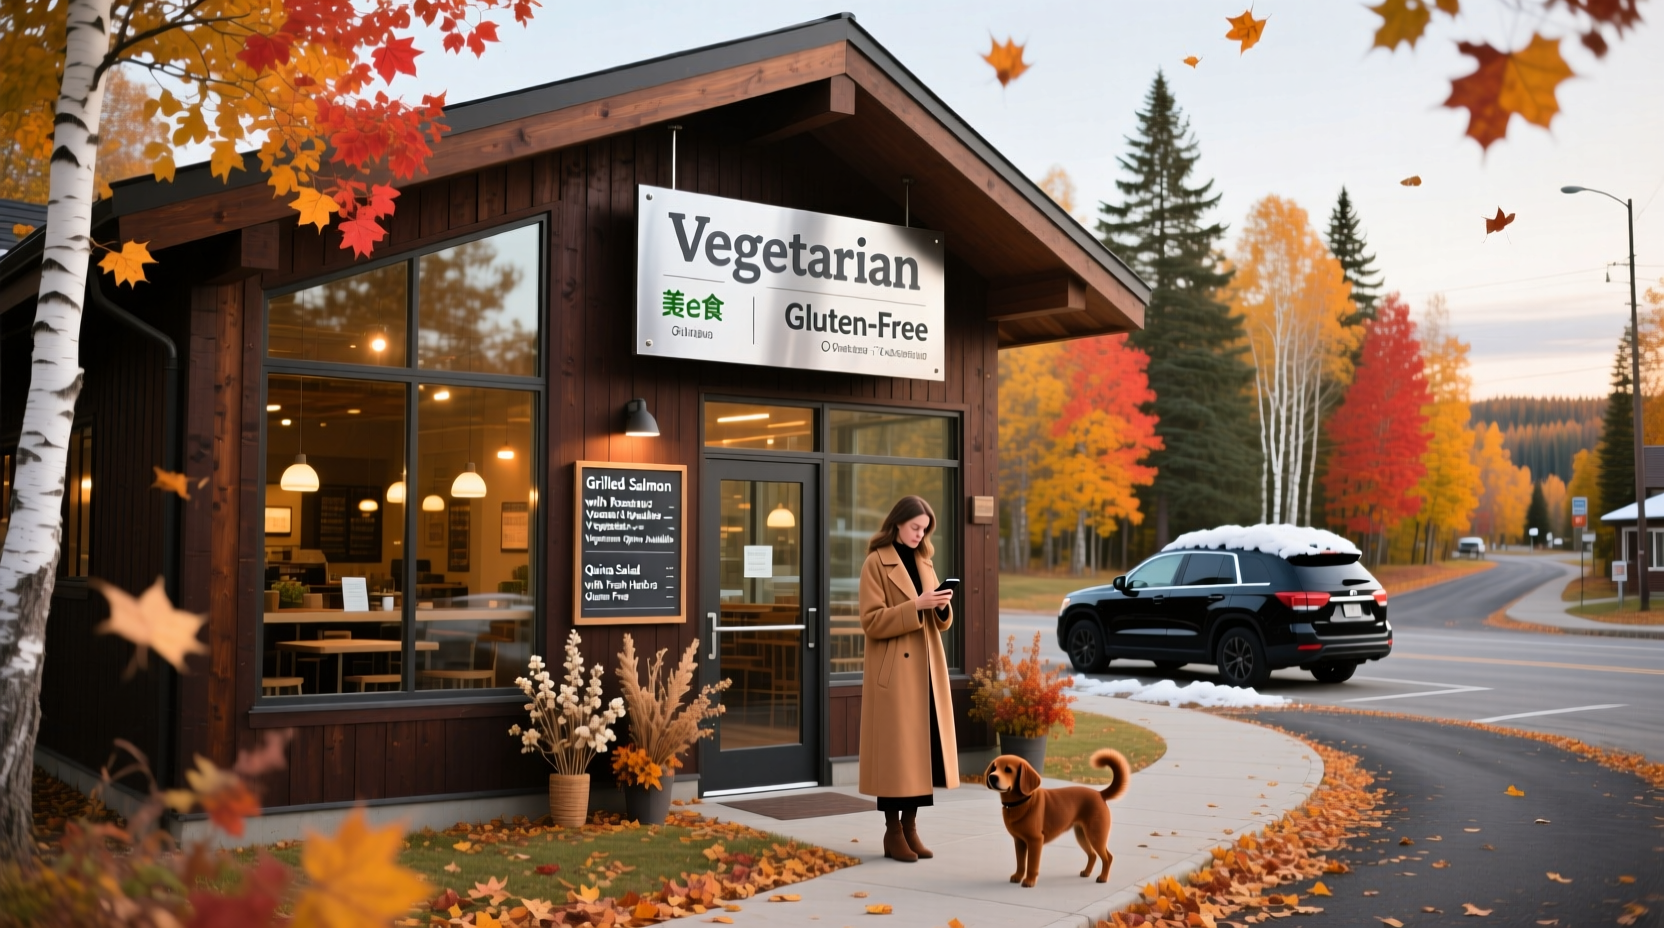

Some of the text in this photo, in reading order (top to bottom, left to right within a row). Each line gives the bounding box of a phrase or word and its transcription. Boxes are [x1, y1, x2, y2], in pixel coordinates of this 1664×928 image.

[668, 211, 921, 291] Vegetarian
[784, 302, 929, 342] Gluten-Free
[586, 475, 672, 492] Grilled Salmon
